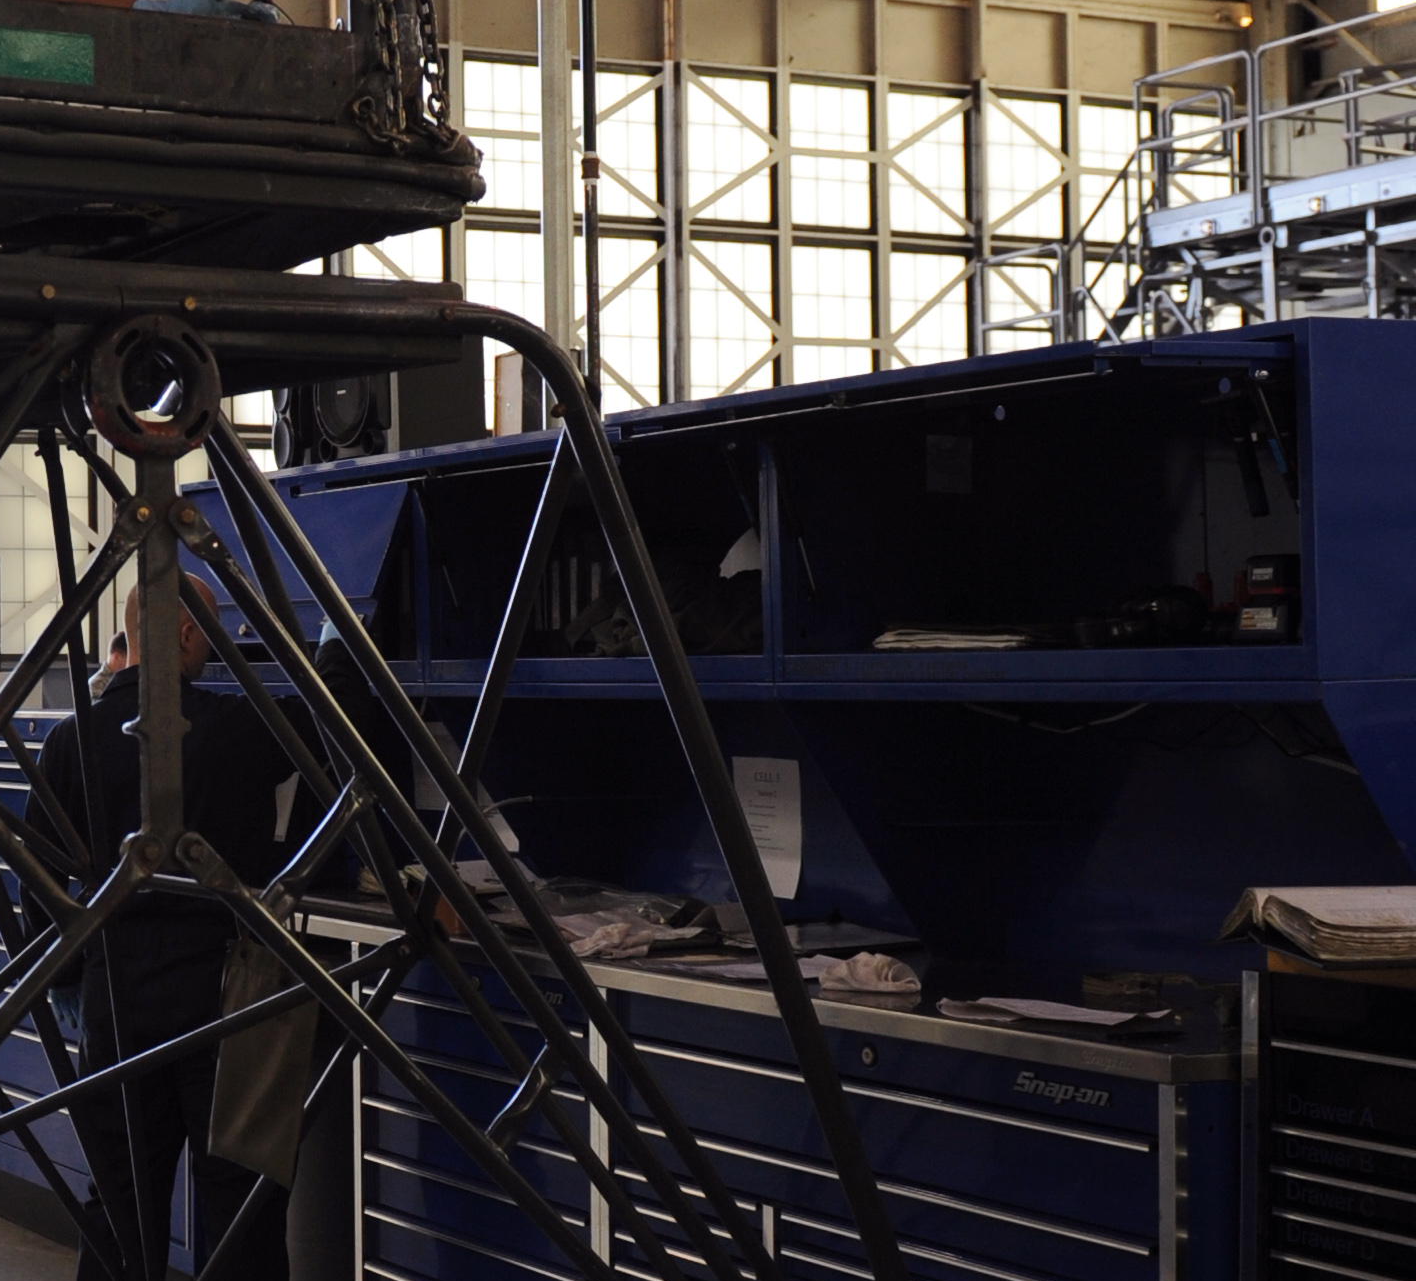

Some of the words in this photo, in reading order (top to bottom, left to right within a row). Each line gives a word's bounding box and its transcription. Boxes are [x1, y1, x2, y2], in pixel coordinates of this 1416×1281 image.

[1012, 1070, 1111, 1107] Snap-on
[1287, 1093, 1356, 1124] Drawer
[1358, 1106, 1375, 1129] A
[1286, 1137, 1354, 1169] Drawer
[1360, 1152, 1374, 1173] B
[1286, 1180, 1355, 1212] Drawer
[1360, 1195, 1376, 1217] C
[1287, 1222, 1355, 1255] Drawer
[1360, 1240, 1376, 1261] D
